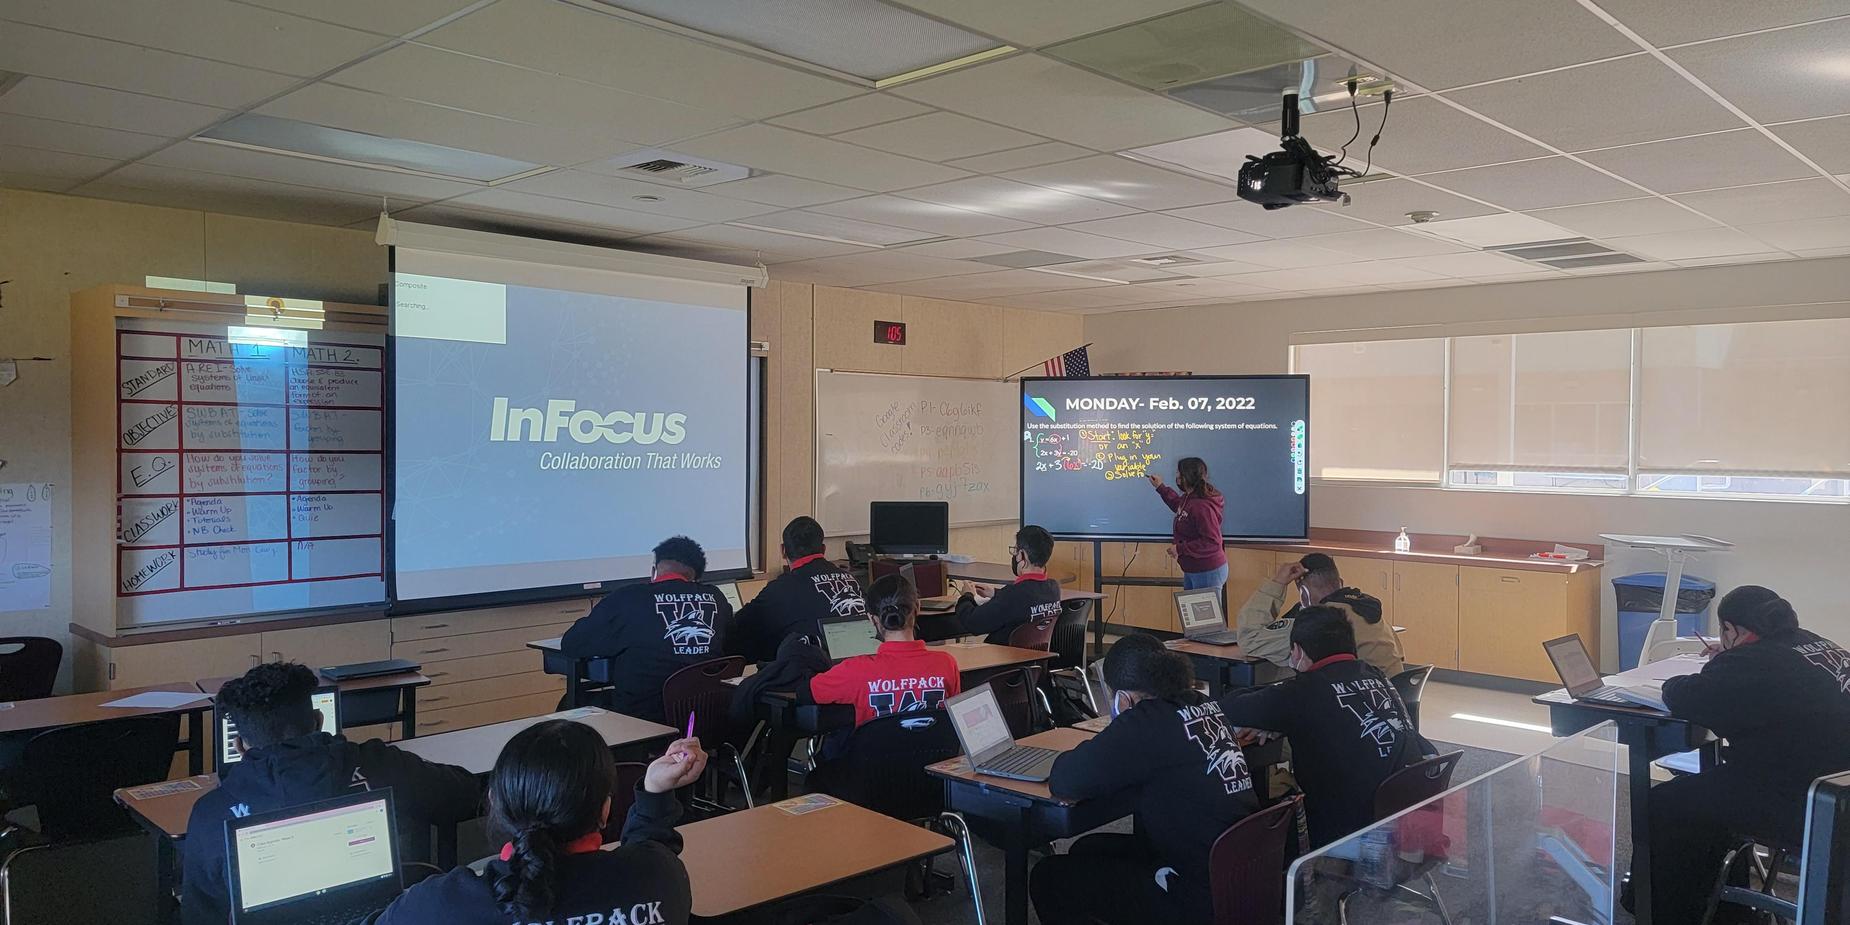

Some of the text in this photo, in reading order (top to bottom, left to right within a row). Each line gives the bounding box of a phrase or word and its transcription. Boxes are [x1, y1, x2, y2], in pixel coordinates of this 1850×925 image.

[188, 338, 240, 355] MATH
[292, 346, 338, 361] MATH
[327, 377, 360, 386] produce
[1066, 396, 1256, 412] MONDAY- Feb. 07, 2022
[490, 396, 687, 445] InFocus
[1027, 421, 1279, 433] Use the substitution method to find the solution of the following system of equations.
[187, 454, 211, 464] How
[213, 454, 226, 463] do
[540, 451, 722, 471] Collaboration That Works
[190, 497, 225, 508] Agenda
[296, 495, 328, 505] Agenda
[191, 506, 233, 517] Warm Up
[296, 504, 322, 512] Warm
[653, 593, 718, 603] WOLFPACK
[673, 645, 711, 656] LEADER
[868, 676, 946, 693] WOLFPACK
